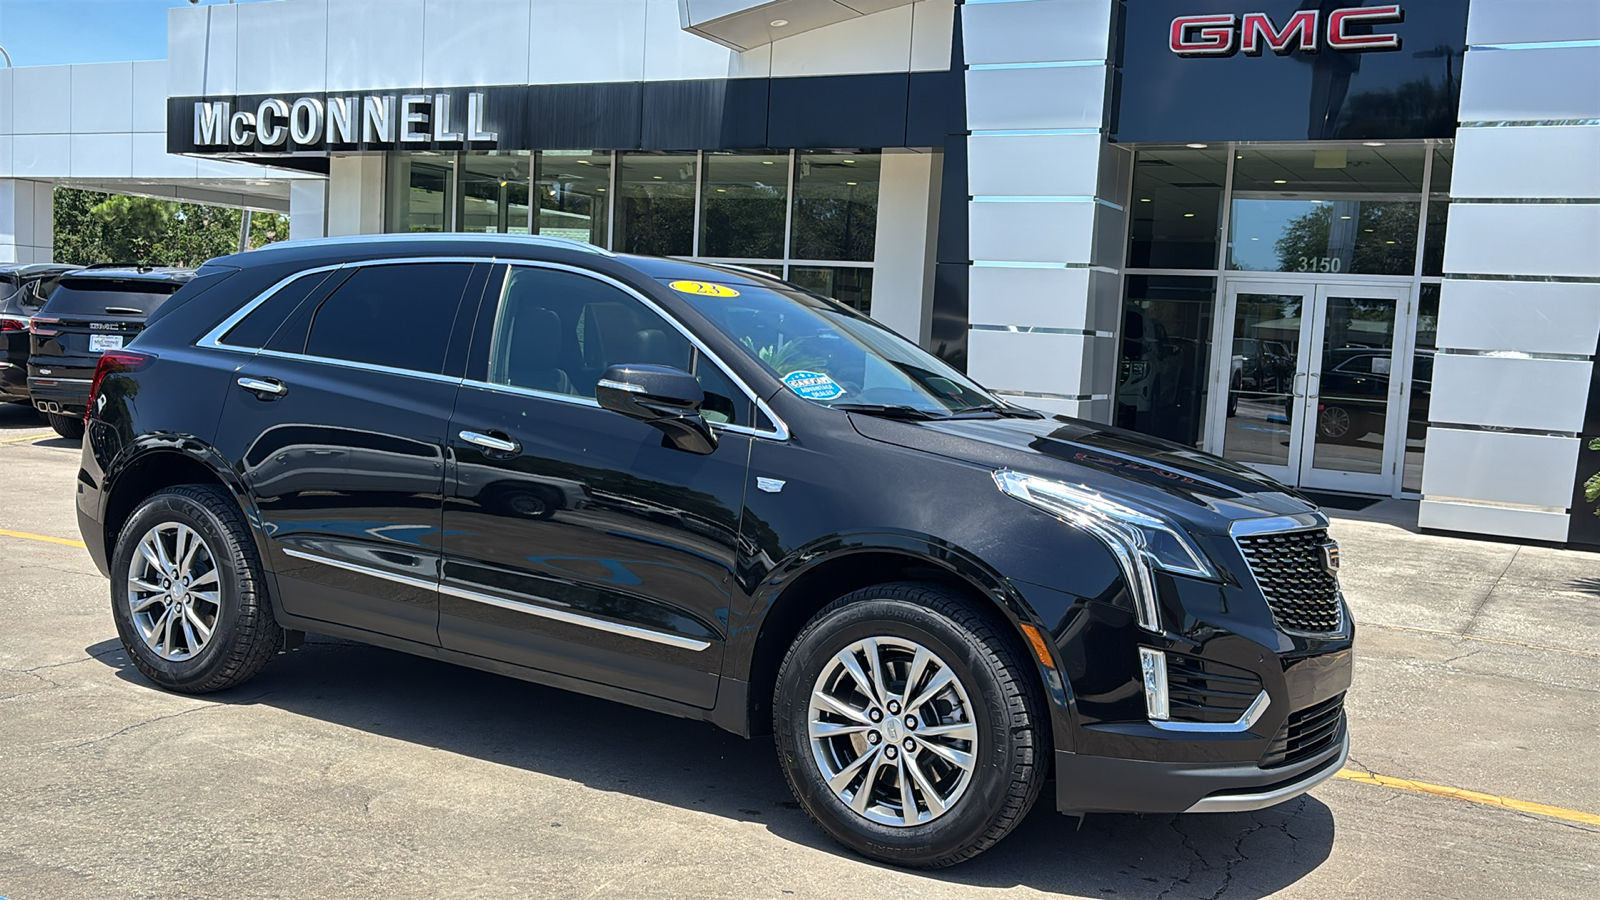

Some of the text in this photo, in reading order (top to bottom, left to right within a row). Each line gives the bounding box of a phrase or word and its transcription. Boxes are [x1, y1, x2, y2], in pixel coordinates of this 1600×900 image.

[1169, 5, 1402, 54] GMC
[193, 92, 498, 147] McCONNELL
[1298, 256, 1341, 273] 3150
[690, 283, 720, 294] 23
[89, 322, 119, 331] GMC
[800, 384, 835, 393] ADVANTAGE
[872, 608, 922, 624] TOURING
